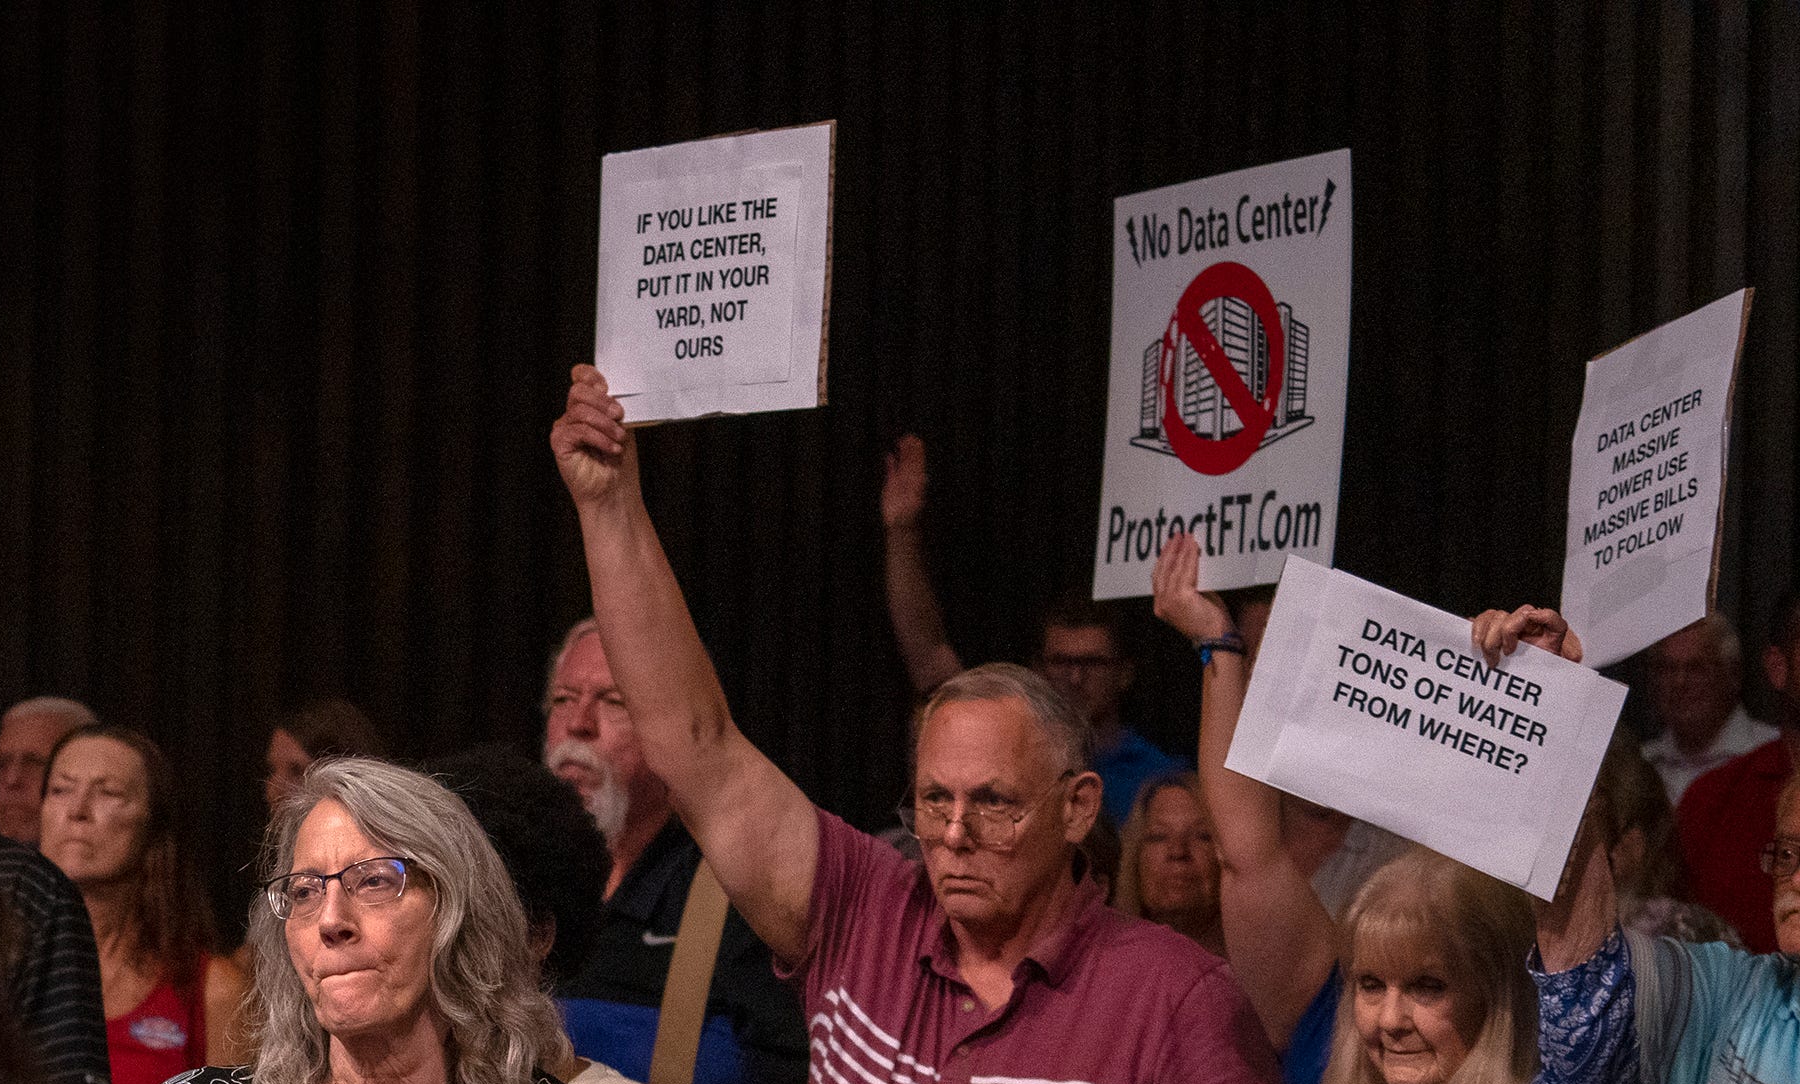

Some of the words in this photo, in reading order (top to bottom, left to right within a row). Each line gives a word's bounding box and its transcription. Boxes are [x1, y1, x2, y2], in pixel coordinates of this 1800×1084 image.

[637, 213, 652, 234] IF
[657, 207, 693, 231] YOU
[698, 202, 737, 227] LIKE
[742, 197, 778, 221] THE
[1142, 213, 1171, 262] No
[1177, 206, 1230, 256] Data
[1236, 194, 1319, 244] Center
[642, 243, 686, 266] DATA
[690, 232, 767, 260] CENTER,
[637, 275, 672, 299] PUT
[676, 273, 691, 294] IT
[696, 271, 713, 292] IN
[719, 265, 770, 289] YOUR
[656, 305, 706, 329] YARD,
[710, 300, 749, 324] NOT
[674, 335, 724, 360] OURS
[1596, 421, 1635, 453] DATA
[1640, 389, 1702, 432] CENTER
[1612, 427, 1680, 475] MASSIVE
[1597, 469, 1653, 510] POWER
[1657, 451, 1688, 482] USE
[1583, 499, 1650, 545] MASSIVE
[1653, 477, 1699, 514] BILLS
[1594, 545, 1613, 570] TO
[1616, 513, 1684, 559] FOLLOW
[1361, 618, 1426, 662] DATA
[1435, 648, 1543, 707] CENTER
[1338, 644, 1408, 690] TONS
[1414, 677, 1453, 705] OF
[1457, 692, 1548, 747] WATER
[1332, 681, 1412, 730] FROM
[1417, 713, 1529, 775] WHERE?
